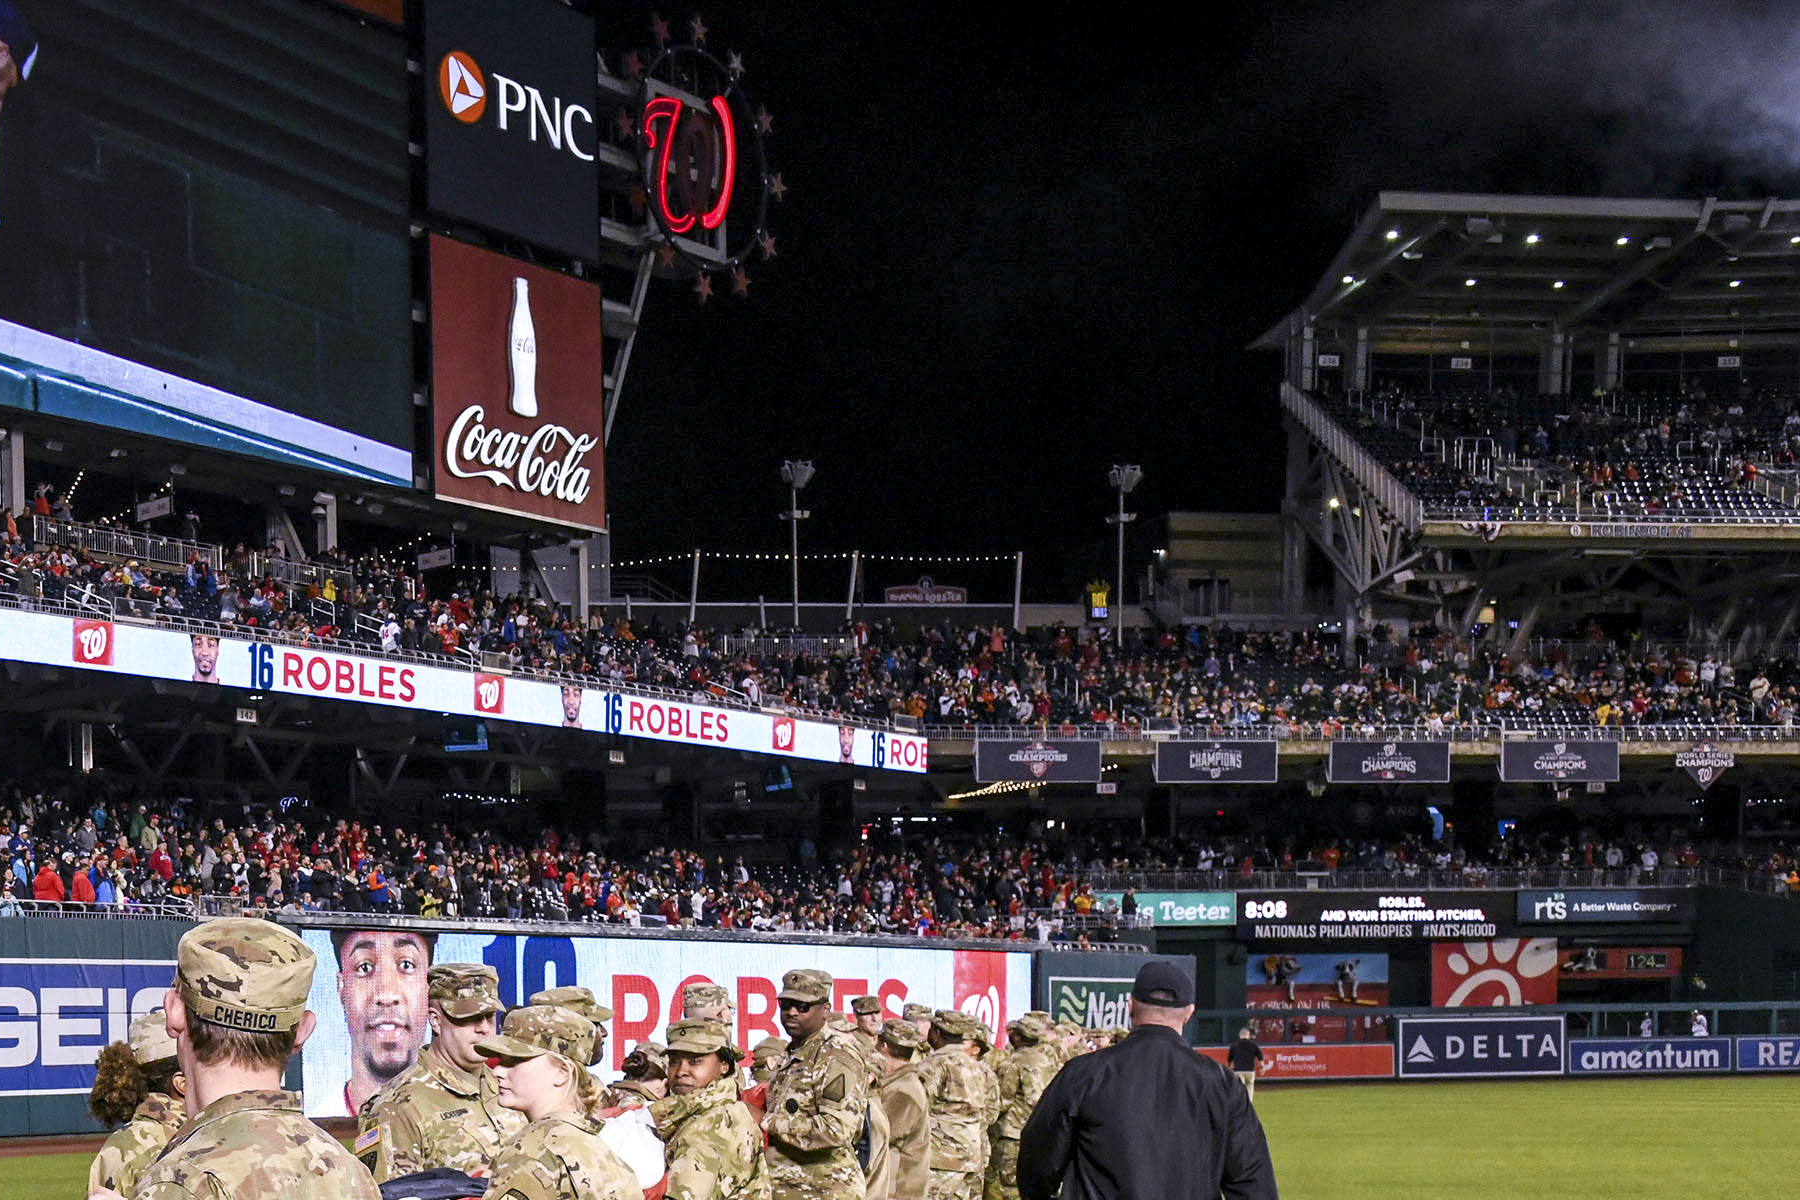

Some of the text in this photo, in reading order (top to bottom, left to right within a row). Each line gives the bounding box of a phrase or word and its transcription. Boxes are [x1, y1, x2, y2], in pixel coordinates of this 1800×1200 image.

[492, 73, 595, 162] PNC
[446, 404, 598, 504] Coca-Cola
[248, 641, 416, 703] 16 ROBLES
[241, 710, 254, 720] 142
[603, 693, 729, 743] 16 ROBLES
[871, 732, 885, 768] 16
[1189, 750, 1242, 769] CHAMPIONS
[1676, 752, 1734, 760] WORLD SERIES
[1362, 760, 1417, 774] CHAMPIONS
[1534, 760, 1587, 770] CHAMPIONS
[1675, 759, 1735, 768] CHAMPIONS
[1160, 901, 1231, 921] Teeter
[1245, 900, 1288, 919] 8:08
[1321, 909, 1347, 922] AND
[1348, 909, 1379, 922] YOUR
[1380, 909, 1435, 922] STARTING
[1535, 897, 1567, 920] rts
[1572, 902, 1672, 913] A Better Waste Company
[1255, 923, 1496, 939] NATIONALS PHILANTHROPIES #NATS4GOOD
[213, 1006, 277, 1030] CHERICO
[1086, 992, 1132, 1030] Nati
[1445, 1033, 1559, 1059] DELTA
[1581, 1043, 1720, 1070] amentum
